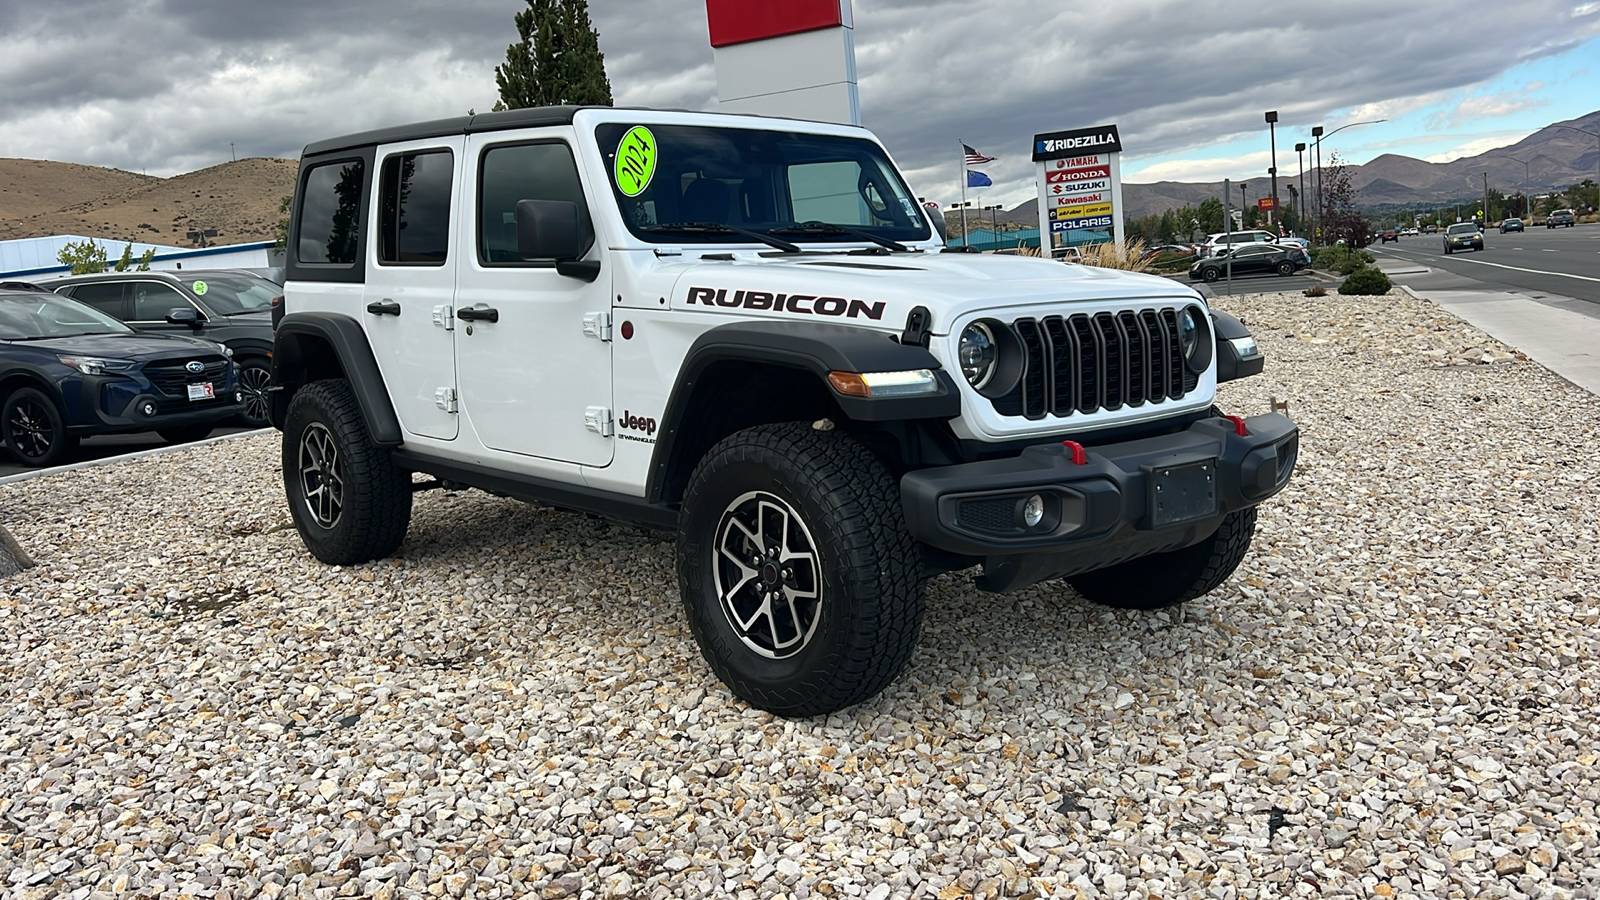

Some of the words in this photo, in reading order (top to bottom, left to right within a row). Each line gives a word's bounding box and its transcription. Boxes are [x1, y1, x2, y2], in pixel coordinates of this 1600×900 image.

[1055, 133, 1115, 149] RIDEZILLA
[622, 131, 651, 189] 2024
[1066, 156, 1099, 168] YAMAHA
[1062, 170, 1107, 181] HONDA
[1065, 181, 1105, 192] SUZUKI
[1058, 193, 1102, 205] Kawasaki
[1053, 217, 1111, 230] POLARIS
[686, 287, 887, 320] RUBICON
[619, 410, 656, 435] Jeep
